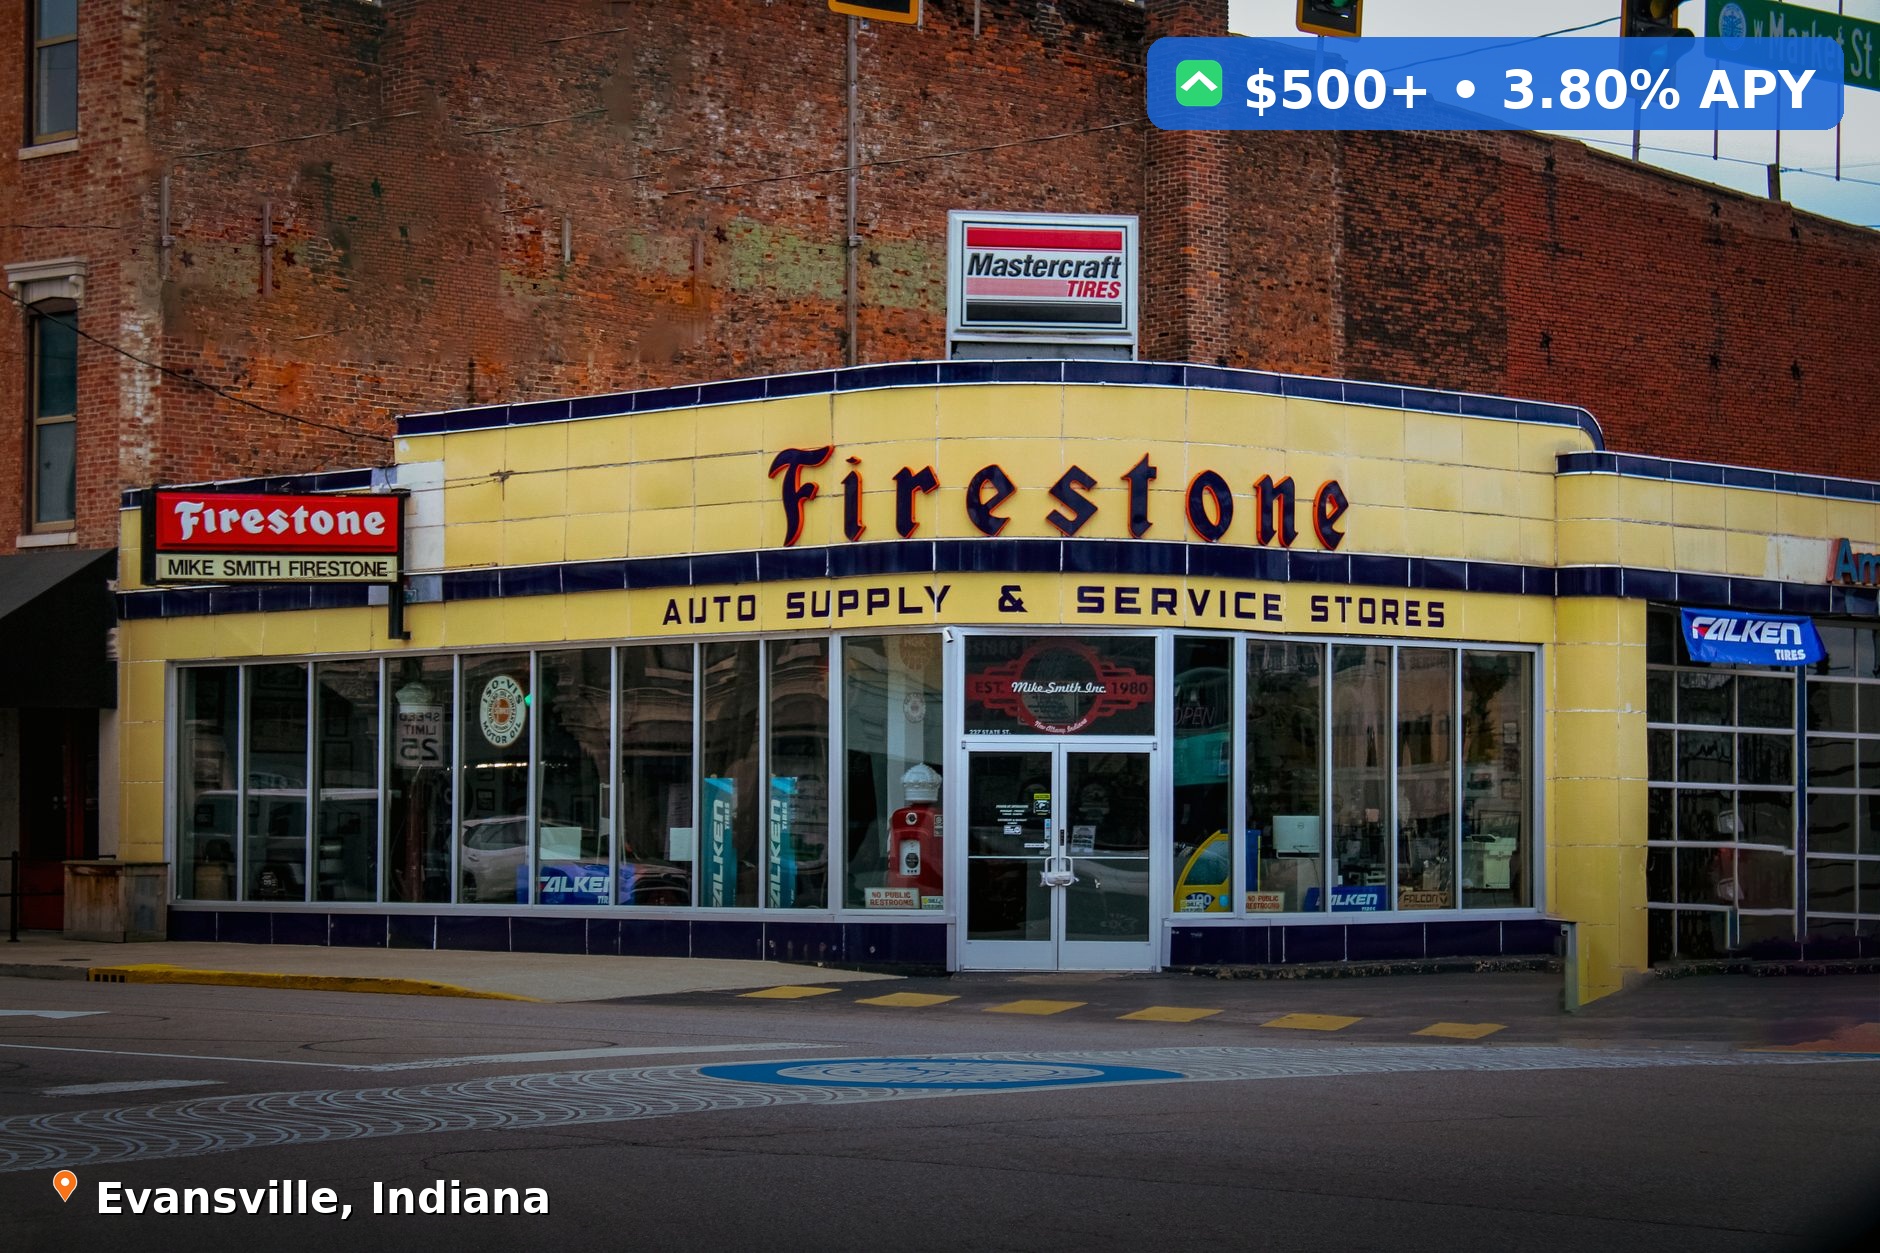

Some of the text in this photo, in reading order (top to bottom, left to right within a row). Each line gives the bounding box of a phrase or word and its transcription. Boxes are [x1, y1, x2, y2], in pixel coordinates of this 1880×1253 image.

[1850, 28, 1873, 80] St
[967, 252, 1122, 279] Mastercraft
[1066, 280, 1122, 299] TIRES
[767, 444, 1350, 551] Firestone
[174, 501, 386, 541] Firestone
[168, 559, 388, 577] MIKE SMITH FIRESTONE
[661, 584, 1445, 628] AUTO SUPPLY & SERVICE STORES
[1691, 615, 1802, 646] FALKEN
[1774, 648, 1807, 662] TIRES
[483, 679, 523, 704] ISO-VIS
[1011, 681, 1046, 694] Mike
[1045, 681, 1083, 694] Smith
[1082, 682, 1107, 694] Inc.
[1111, 682, 1148, 695] 1980
[483, 721, 522, 743] MOTOR OIL
[713, 799, 725, 908] ALKEN
[770, 799, 782, 908] ALKEN
[597, 895, 609, 904] TIR
[885, 891, 911, 899] PUBLIC
